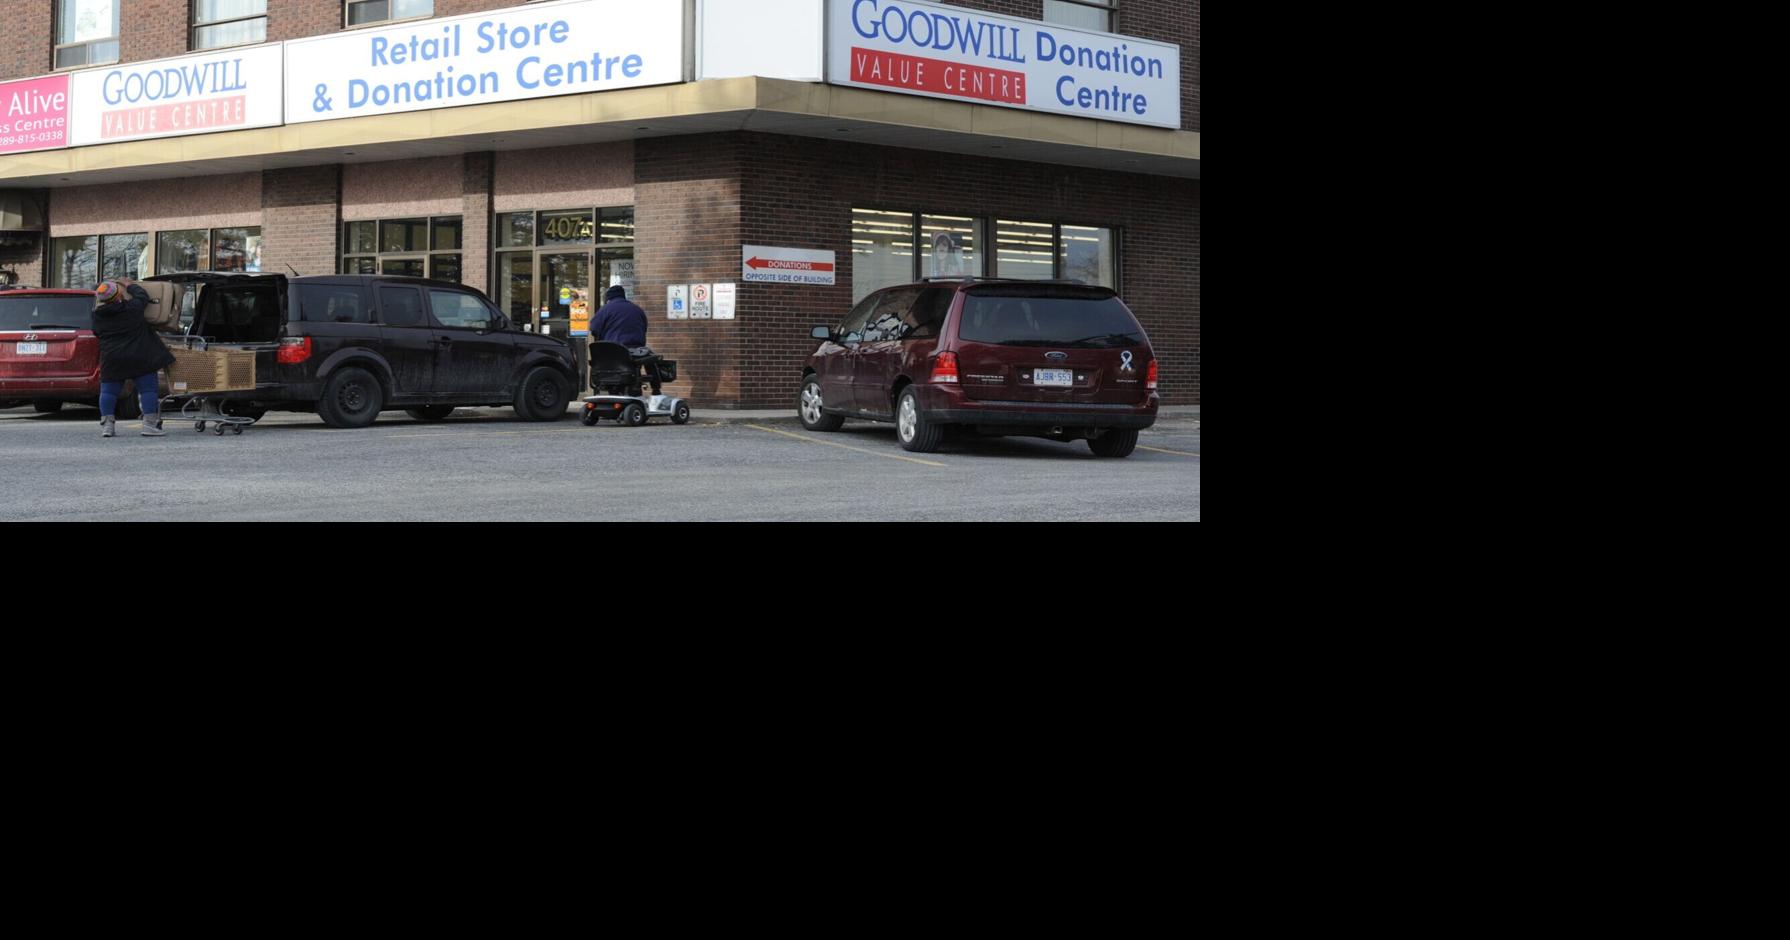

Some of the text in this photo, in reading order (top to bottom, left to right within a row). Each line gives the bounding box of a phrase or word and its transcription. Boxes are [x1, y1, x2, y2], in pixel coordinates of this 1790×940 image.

[371, 19, 570, 66] Retail Store
[851, 0, 1026, 63] GOODWILL
[856, 54, 1022, 99] VALUE CENTRE
[1036, 32, 1163, 79] Donation
[8, 89, 65, 117] Alive
[103, 59, 247, 105] GOODWILL
[312, 53, 643, 113] & Donation Centre
[1055, 75, 1147, 115] Centre
[15, 117, 65, 132] Centre
[104, 101, 242, 134] VALUE CENTRE
[745, 273, 776, 281] OPPOSITE
[778, 274, 791, 282] SIDE
[804, 275, 832, 283] BUILDING
[768, 260, 812, 270] DONATIONS
